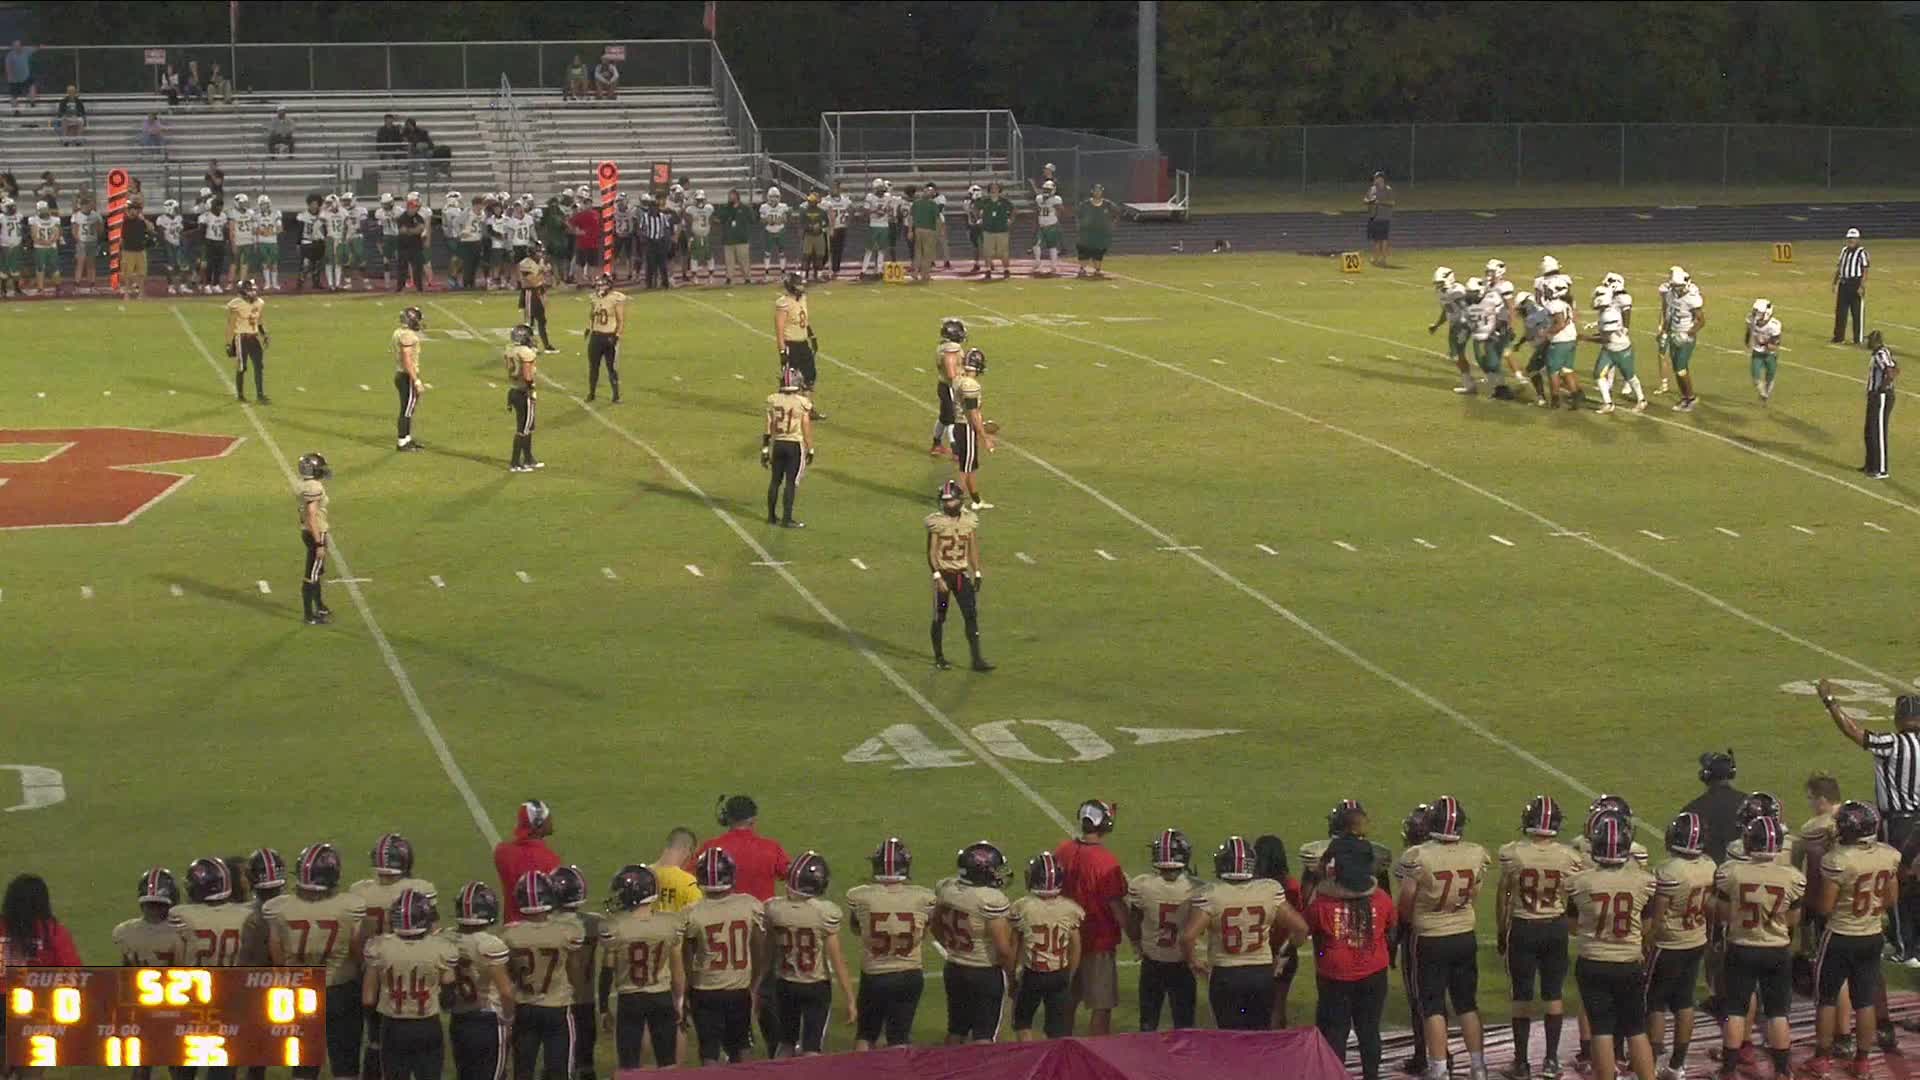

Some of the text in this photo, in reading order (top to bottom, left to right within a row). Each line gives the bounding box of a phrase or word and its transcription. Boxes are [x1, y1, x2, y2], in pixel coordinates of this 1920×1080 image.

[1345, 254, 1360, 269] 20
[1775, 244, 1792, 259] 10
[939, 534, 969, 561] 23
[842, 718, 1116, 770] 40
[1433, 869, 1475, 913] 73
[1519, 868, 1561, 908] 83
[1739, 883, 1787, 929] 57
[869, 911, 915, 957] 53
[1221, 906, 1266, 954] 63
[1590, 892, 1634, 938] 78
[285, 919, 338, 964] 77
[628, 941, 664, 987] 81
[705, 919, 748, 971] 50
[385, 965, 431, 1017] 44
[512, 946, 560, 994] 27
